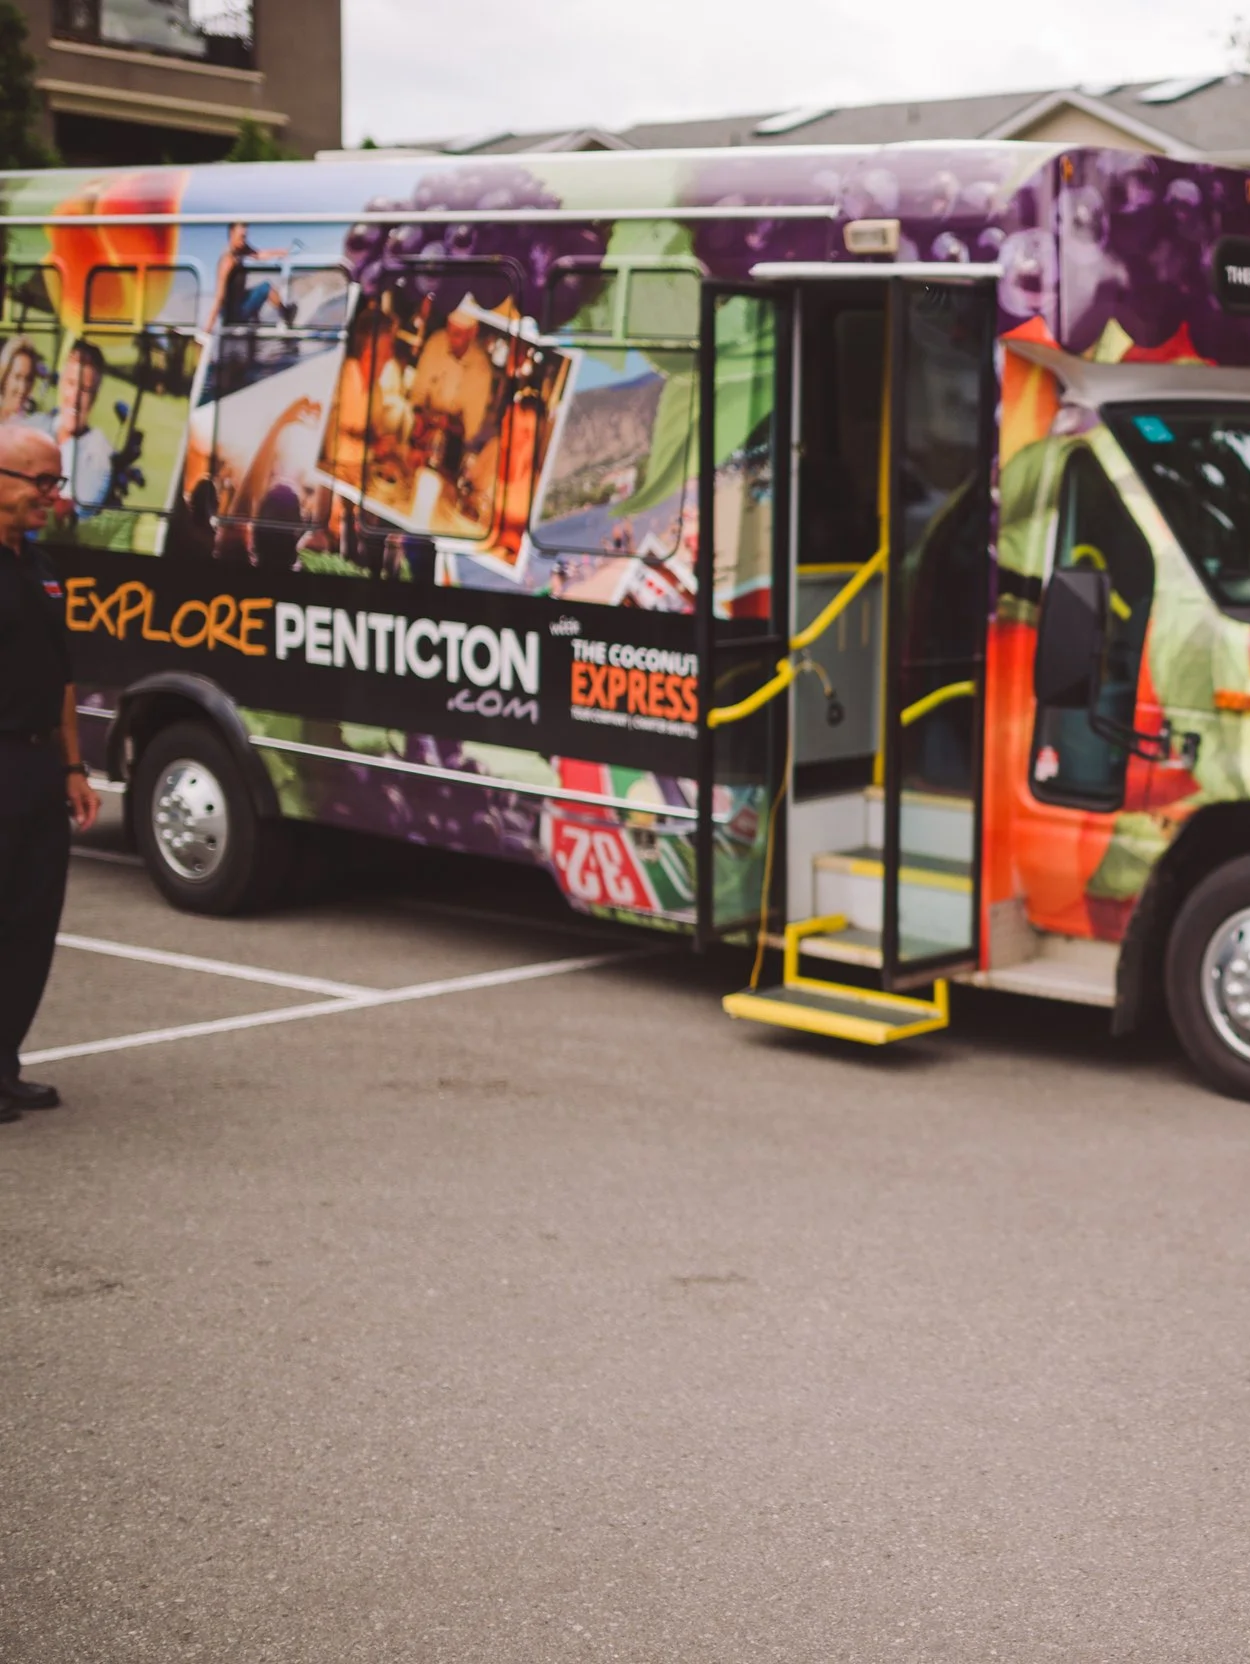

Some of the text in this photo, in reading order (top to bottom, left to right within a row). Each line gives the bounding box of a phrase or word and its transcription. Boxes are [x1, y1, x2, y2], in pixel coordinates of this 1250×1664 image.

[66, 577, 540, 694] EXPLORE PENTICTON
[571, 638, 698, 677] THE COCONUT
[571, 661, 698, 723] EXPRESS
